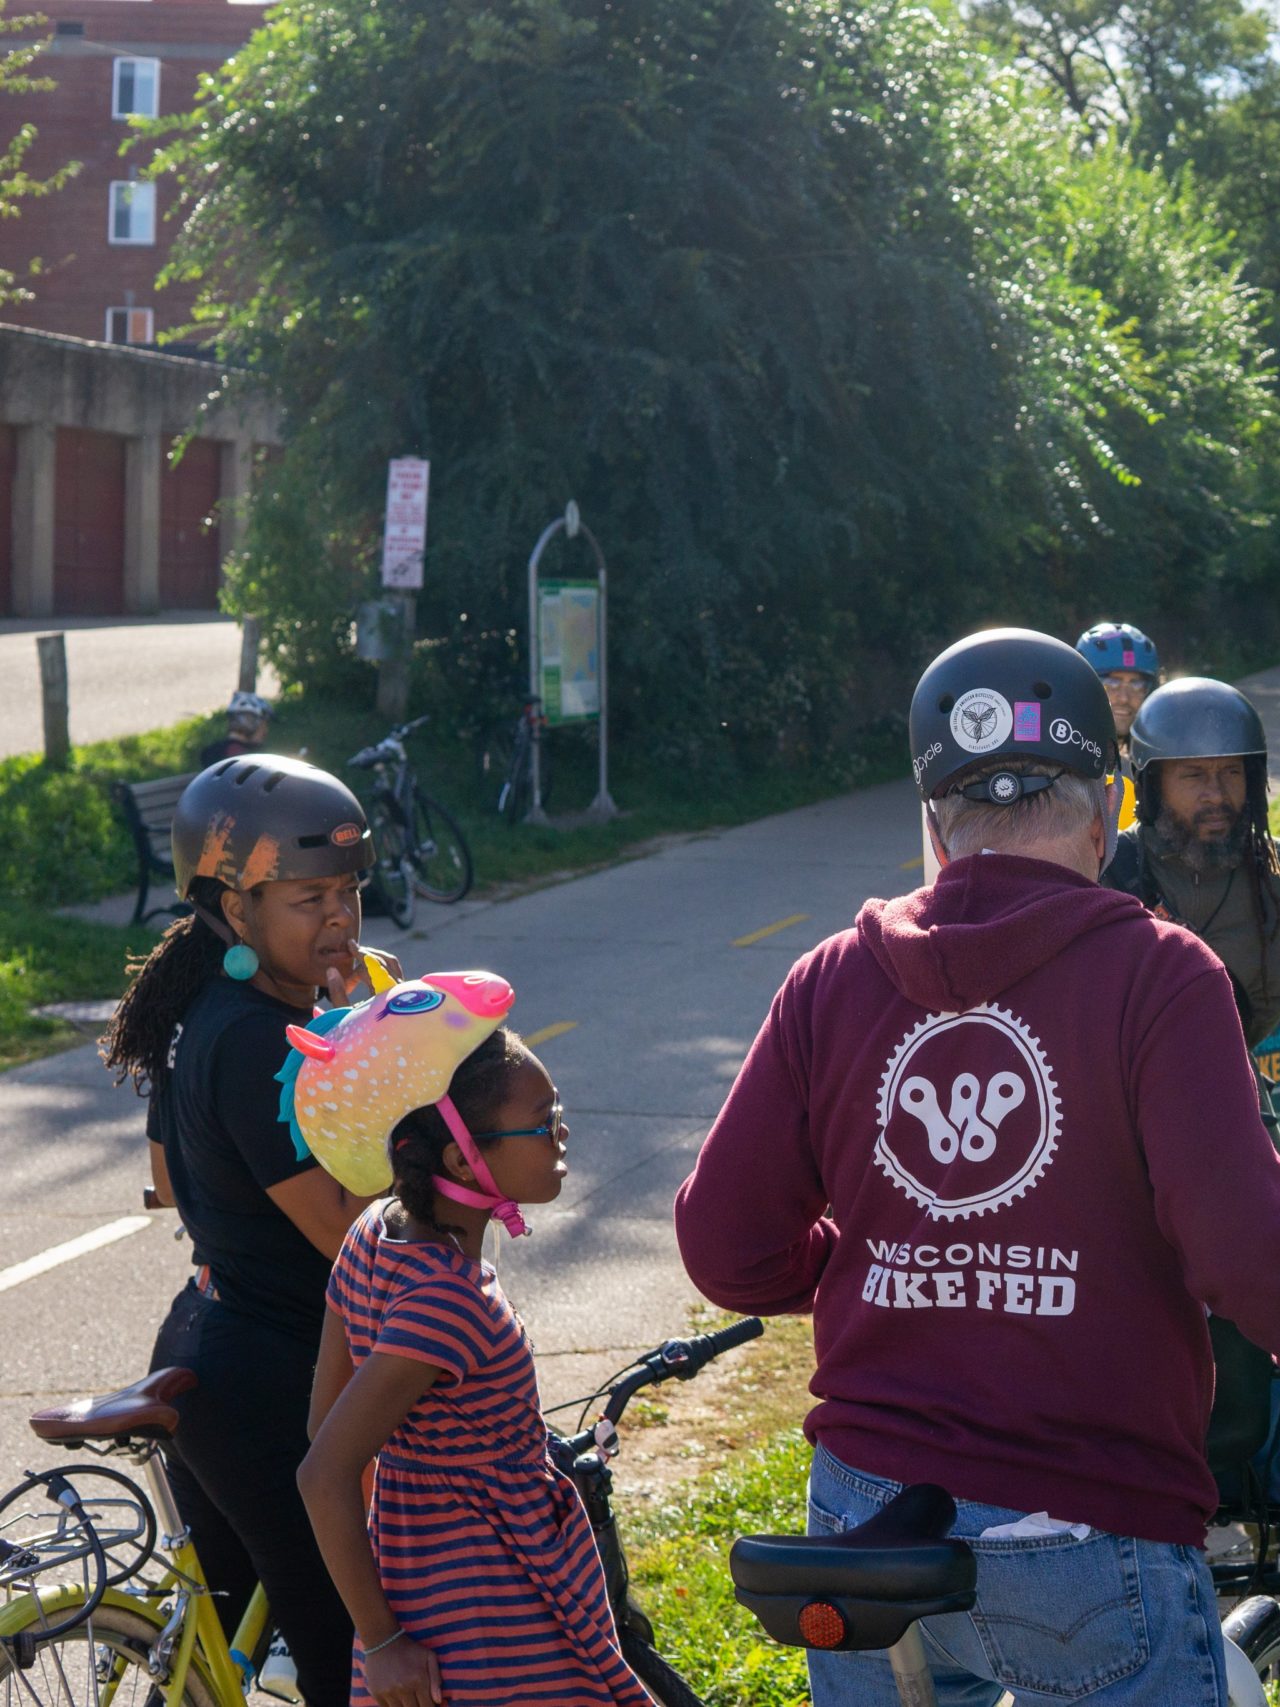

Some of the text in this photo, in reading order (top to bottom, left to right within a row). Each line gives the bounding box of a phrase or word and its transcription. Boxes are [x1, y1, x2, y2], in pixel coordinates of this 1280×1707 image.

[335, 828, 358, 842] BELL
[866, 1239, 1079, 1272] WSCONSIN
[861, 1263, 1076, 1316] BIKE FED
